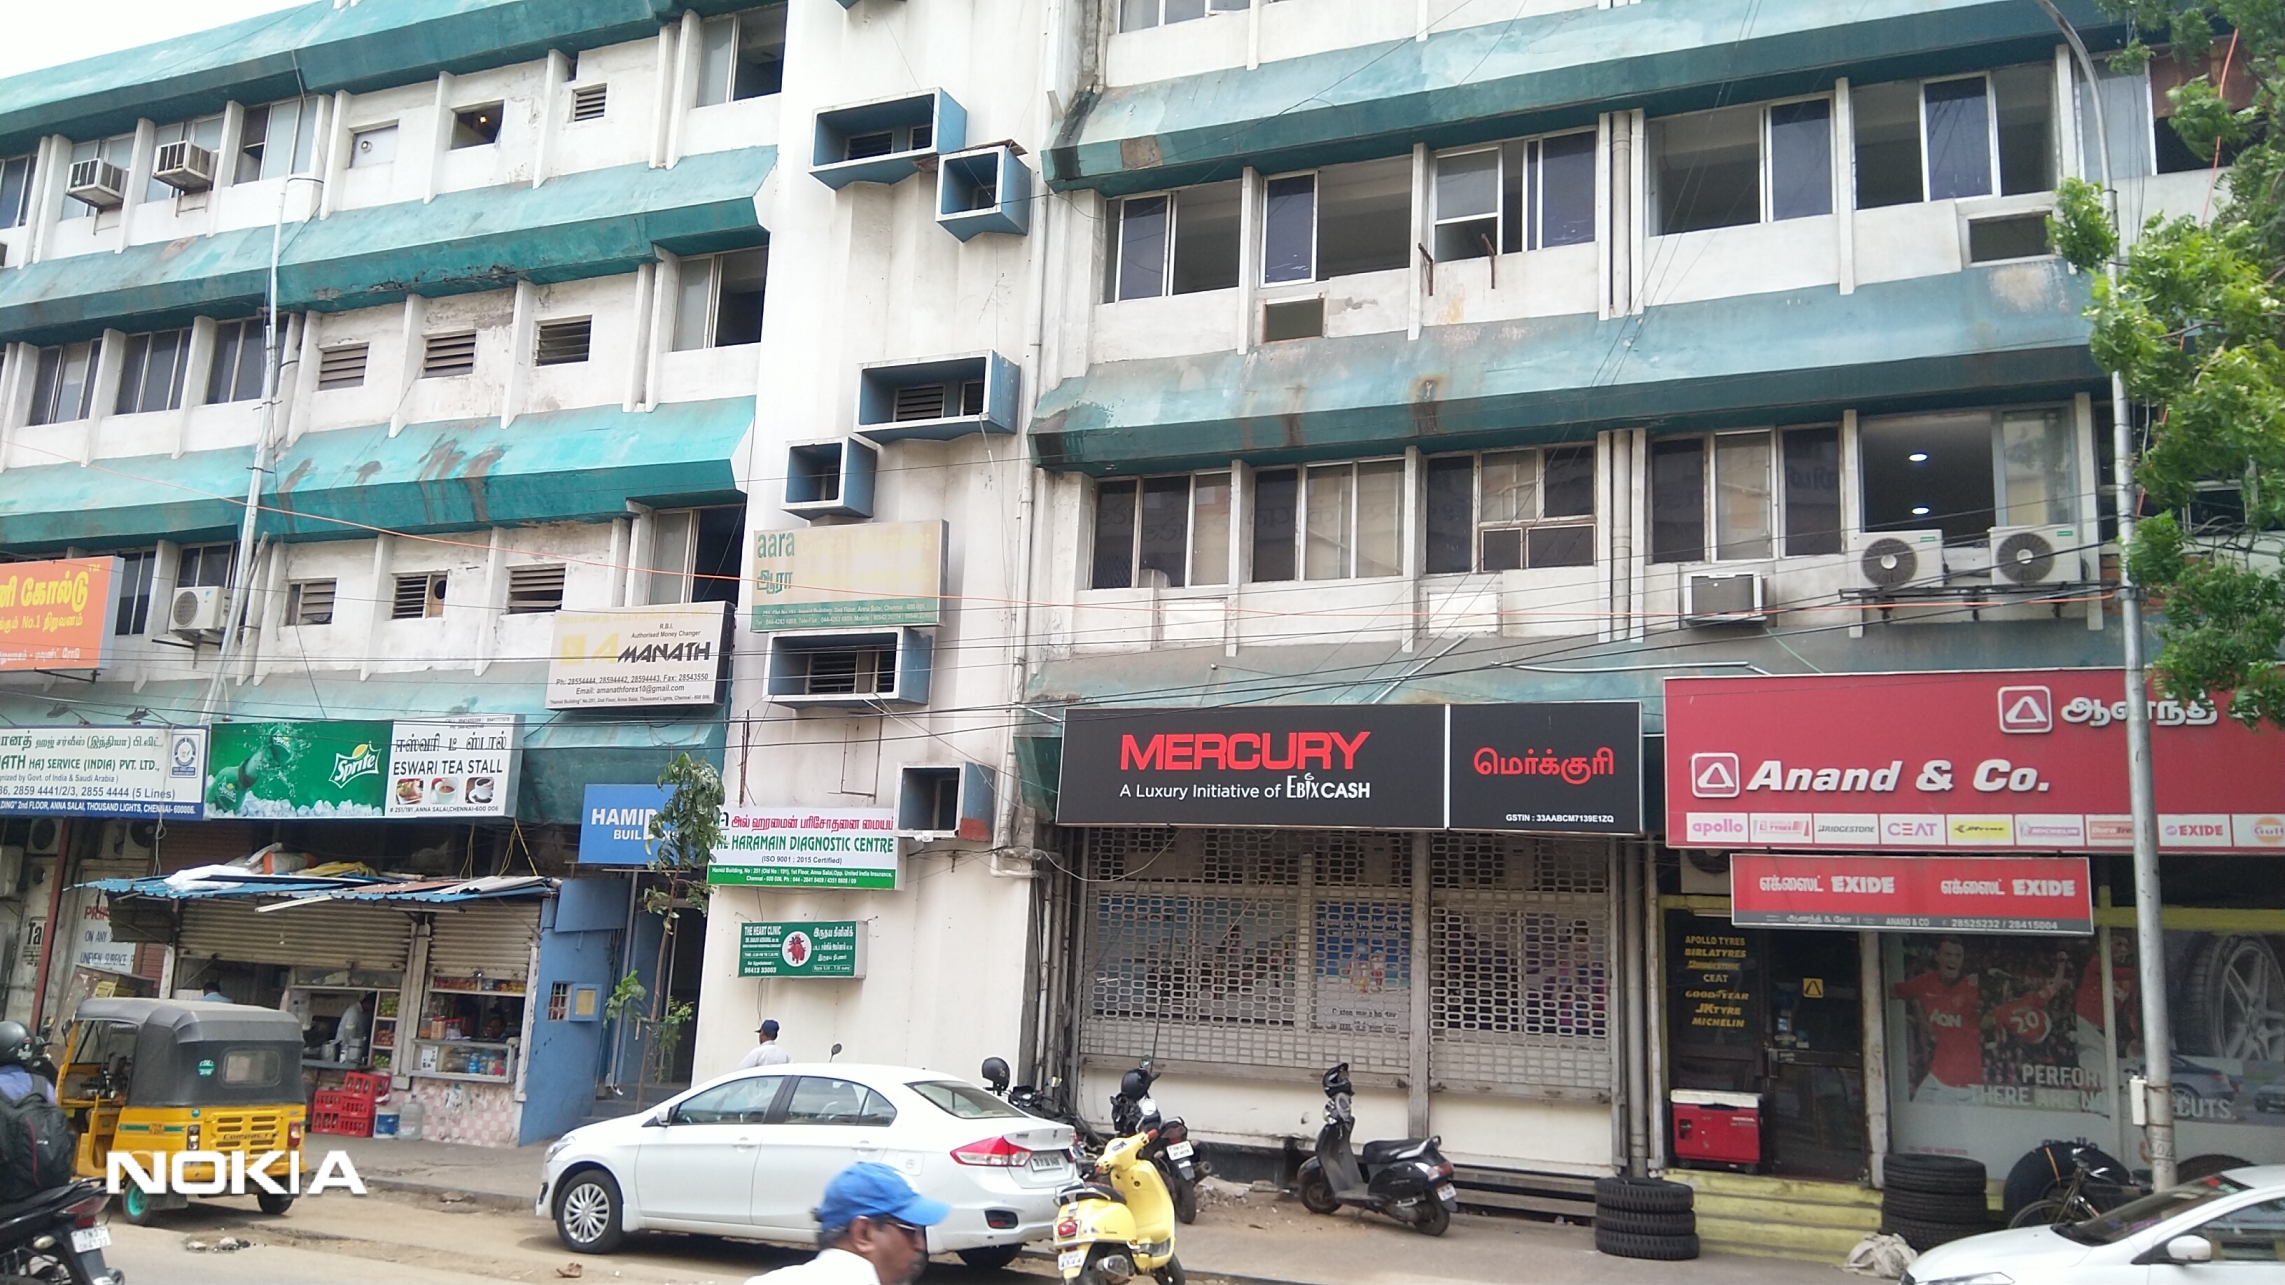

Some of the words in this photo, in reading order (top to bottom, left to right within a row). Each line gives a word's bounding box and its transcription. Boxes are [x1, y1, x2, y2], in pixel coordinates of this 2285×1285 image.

[757, 532, 795, 558] aara
[757, 569, 793, 594] ஆரா
[21, 570, 89, 612] கோல்டு
[22, 615, 40, 628] No.1
[660, 631, 677, 639] Money
[678, 630, 701, 638] Changer
[663, 674, 678, 682] Fax:
[576, 686, 596, 695] Email:
[596, 685, 685, 694] amanathforex10@gmail.com
[1120, 731, 1371, 770] MERCURY
[0, 755, 26, 770] ATH
[29, 758, 45, 771] HAJ
[47, 758, 81, 770] SERVICE
[83, 759, 116, 772] (INDIA)
[119, 759, 137, 770] PVT.
[334, 752, 376, 783] Sprite
[393, 760, 438, 775] ESWARI
[441, 760, 464, 774] TEA
[467, 759, 503, 773] STALL
[1473, 746, 1615, 785] மெர்க்குரி
[19, 774, 26, 783] by
[45, 774, 52, 782] of
[53, 774, 67, 782] India
[69, 774, 74, 782] &
[75, 774, 93, 783] Saudi
[95, 774, 115, 783] Arabia
[1746, 760, 1903, 792] Anand
[1916, 760, 1954, 792] &
[1973, 759, 2050, 792] Co.
[13, 785, 35, 796] 2859
[37, 785, 79, 797] 4441/2/3,
[81, 786, 104, 797] 2855
[106, 787, 129, 797] 4444
[144, 788, 176, 800] Lines)
[1119, 784, 1131, 797] A
[1136, 784, 1188, 800] Luxury
[1193, 783, 1260, 798] Initiative
[1264, 784, 1281, 798] of
[18, 801, 28, 810] 2nd
[29, 801, 50, 811] FLOOR,
[50, 802, 66, 811] ANNA
[87, 802, 119, 811] THOUSAND
[119, 803, 142, 813] LIGHTS,
[1506, 814, 1530, 822] GSTIN
[1692, 819, 1744, 836] apollo
[1818, 825, 1875, 833] BRIDGESTONE
[1887, 822, 1937, 837] CEAT
[2178, 824, 2224, 837] EXIDE
[731, 835, 786, 851] HARAMAIN
[790, 836, 851, 851] DIAGNOSTIC
[854, 838, 893, 854] CENTRE
[813, 857, 842, 865] Certified)
[1831, 876, 1895, 893] EXIDE
[2012, 879, 2076, 896] EXIDE
[1886, 917, 1910, 926] ANAND
[1919, 918, 1930, 927] CO
[753, 926, 767, 935] HEART
[767, 925, 782, 936] CLINIC
[1685, 935, 1717, 945] APOLLO
[1718, 936, 1746, 946] TYRES
[1703, 973, 1729, 983] CEAT
[1691, 1017, 1745, 1028] MICHELIN
[2010, 1010, 2039, 1034] 20
[2021, 1063, 2098, 1088] PERFOR
